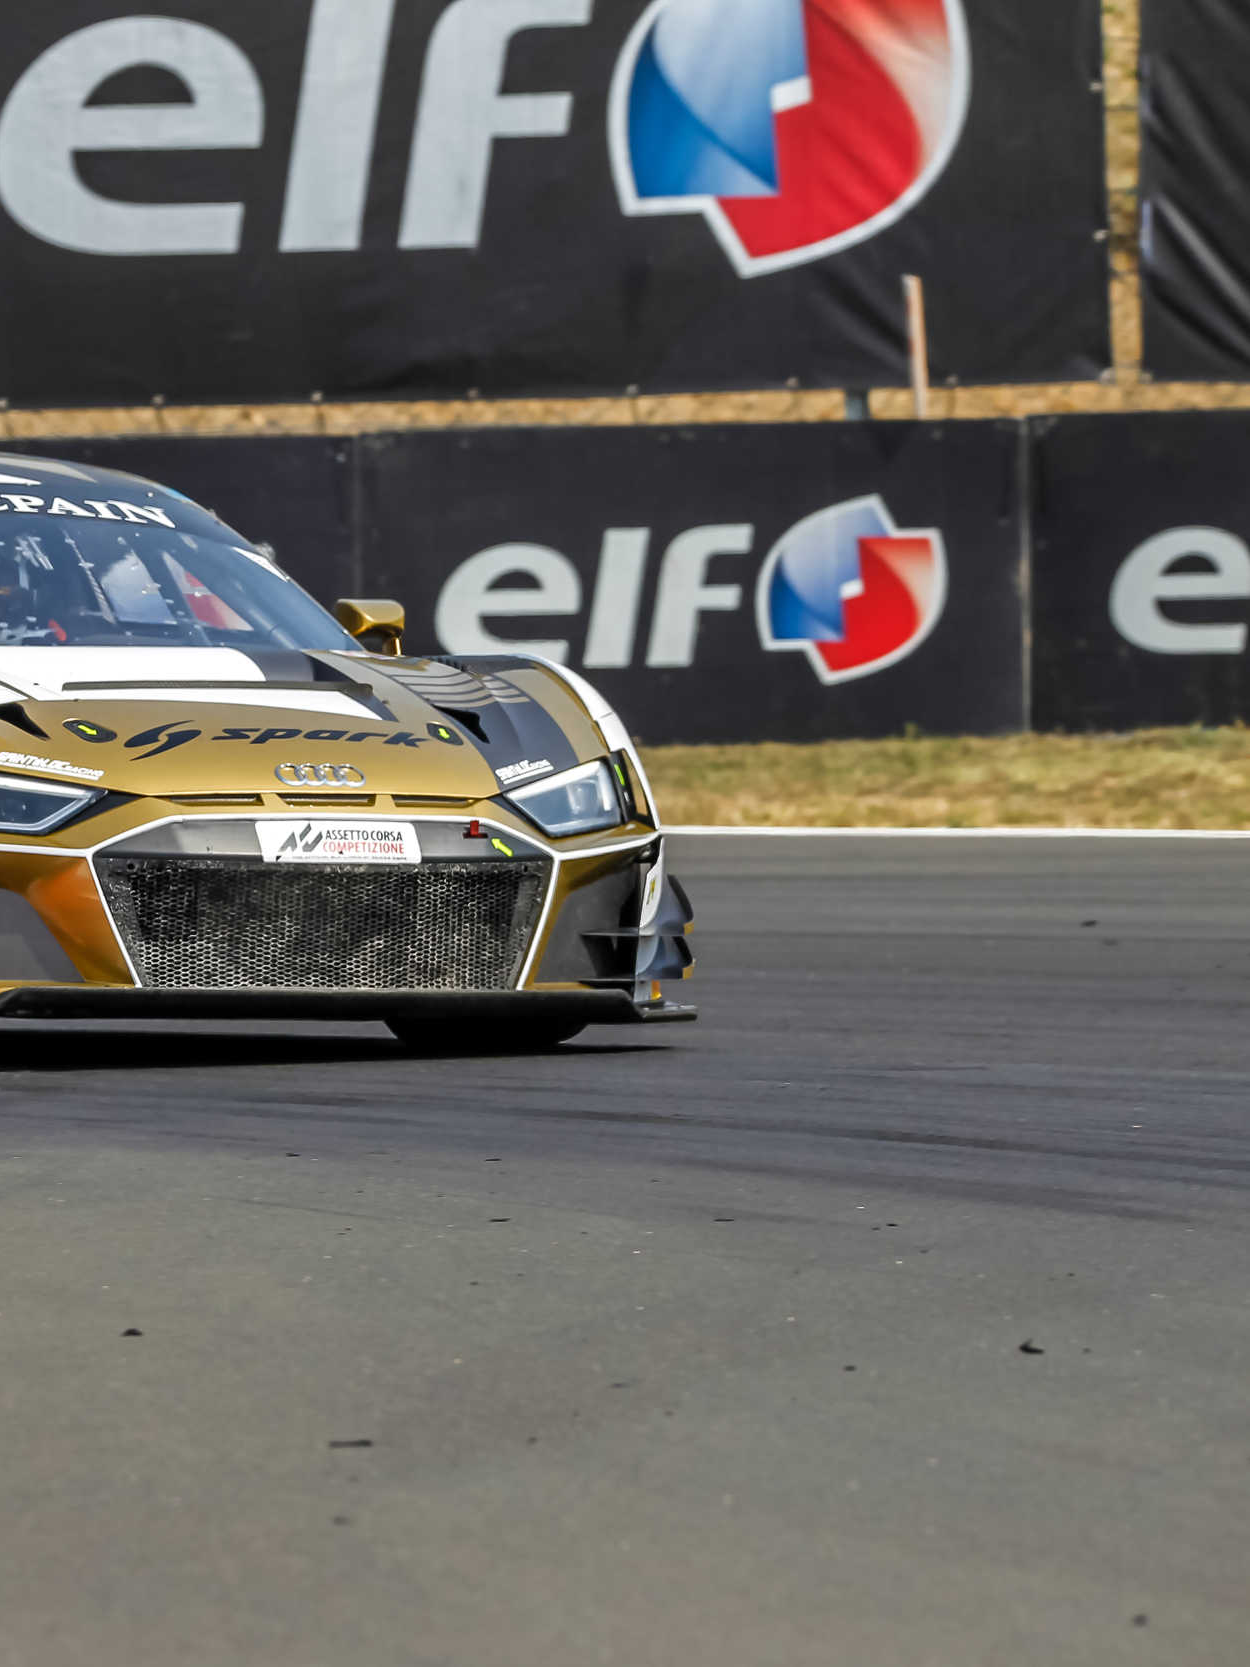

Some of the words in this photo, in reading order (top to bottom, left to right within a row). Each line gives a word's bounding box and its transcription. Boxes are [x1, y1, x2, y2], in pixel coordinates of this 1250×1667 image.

[435, 523, 754, 668] elf
[211, 728, 431, 748] spark
[325, 829, 369, 841] ASSETTO
[370, 830, 403, 841] CORSA
[323, 841, 404, 854] COMPETIZIONE
